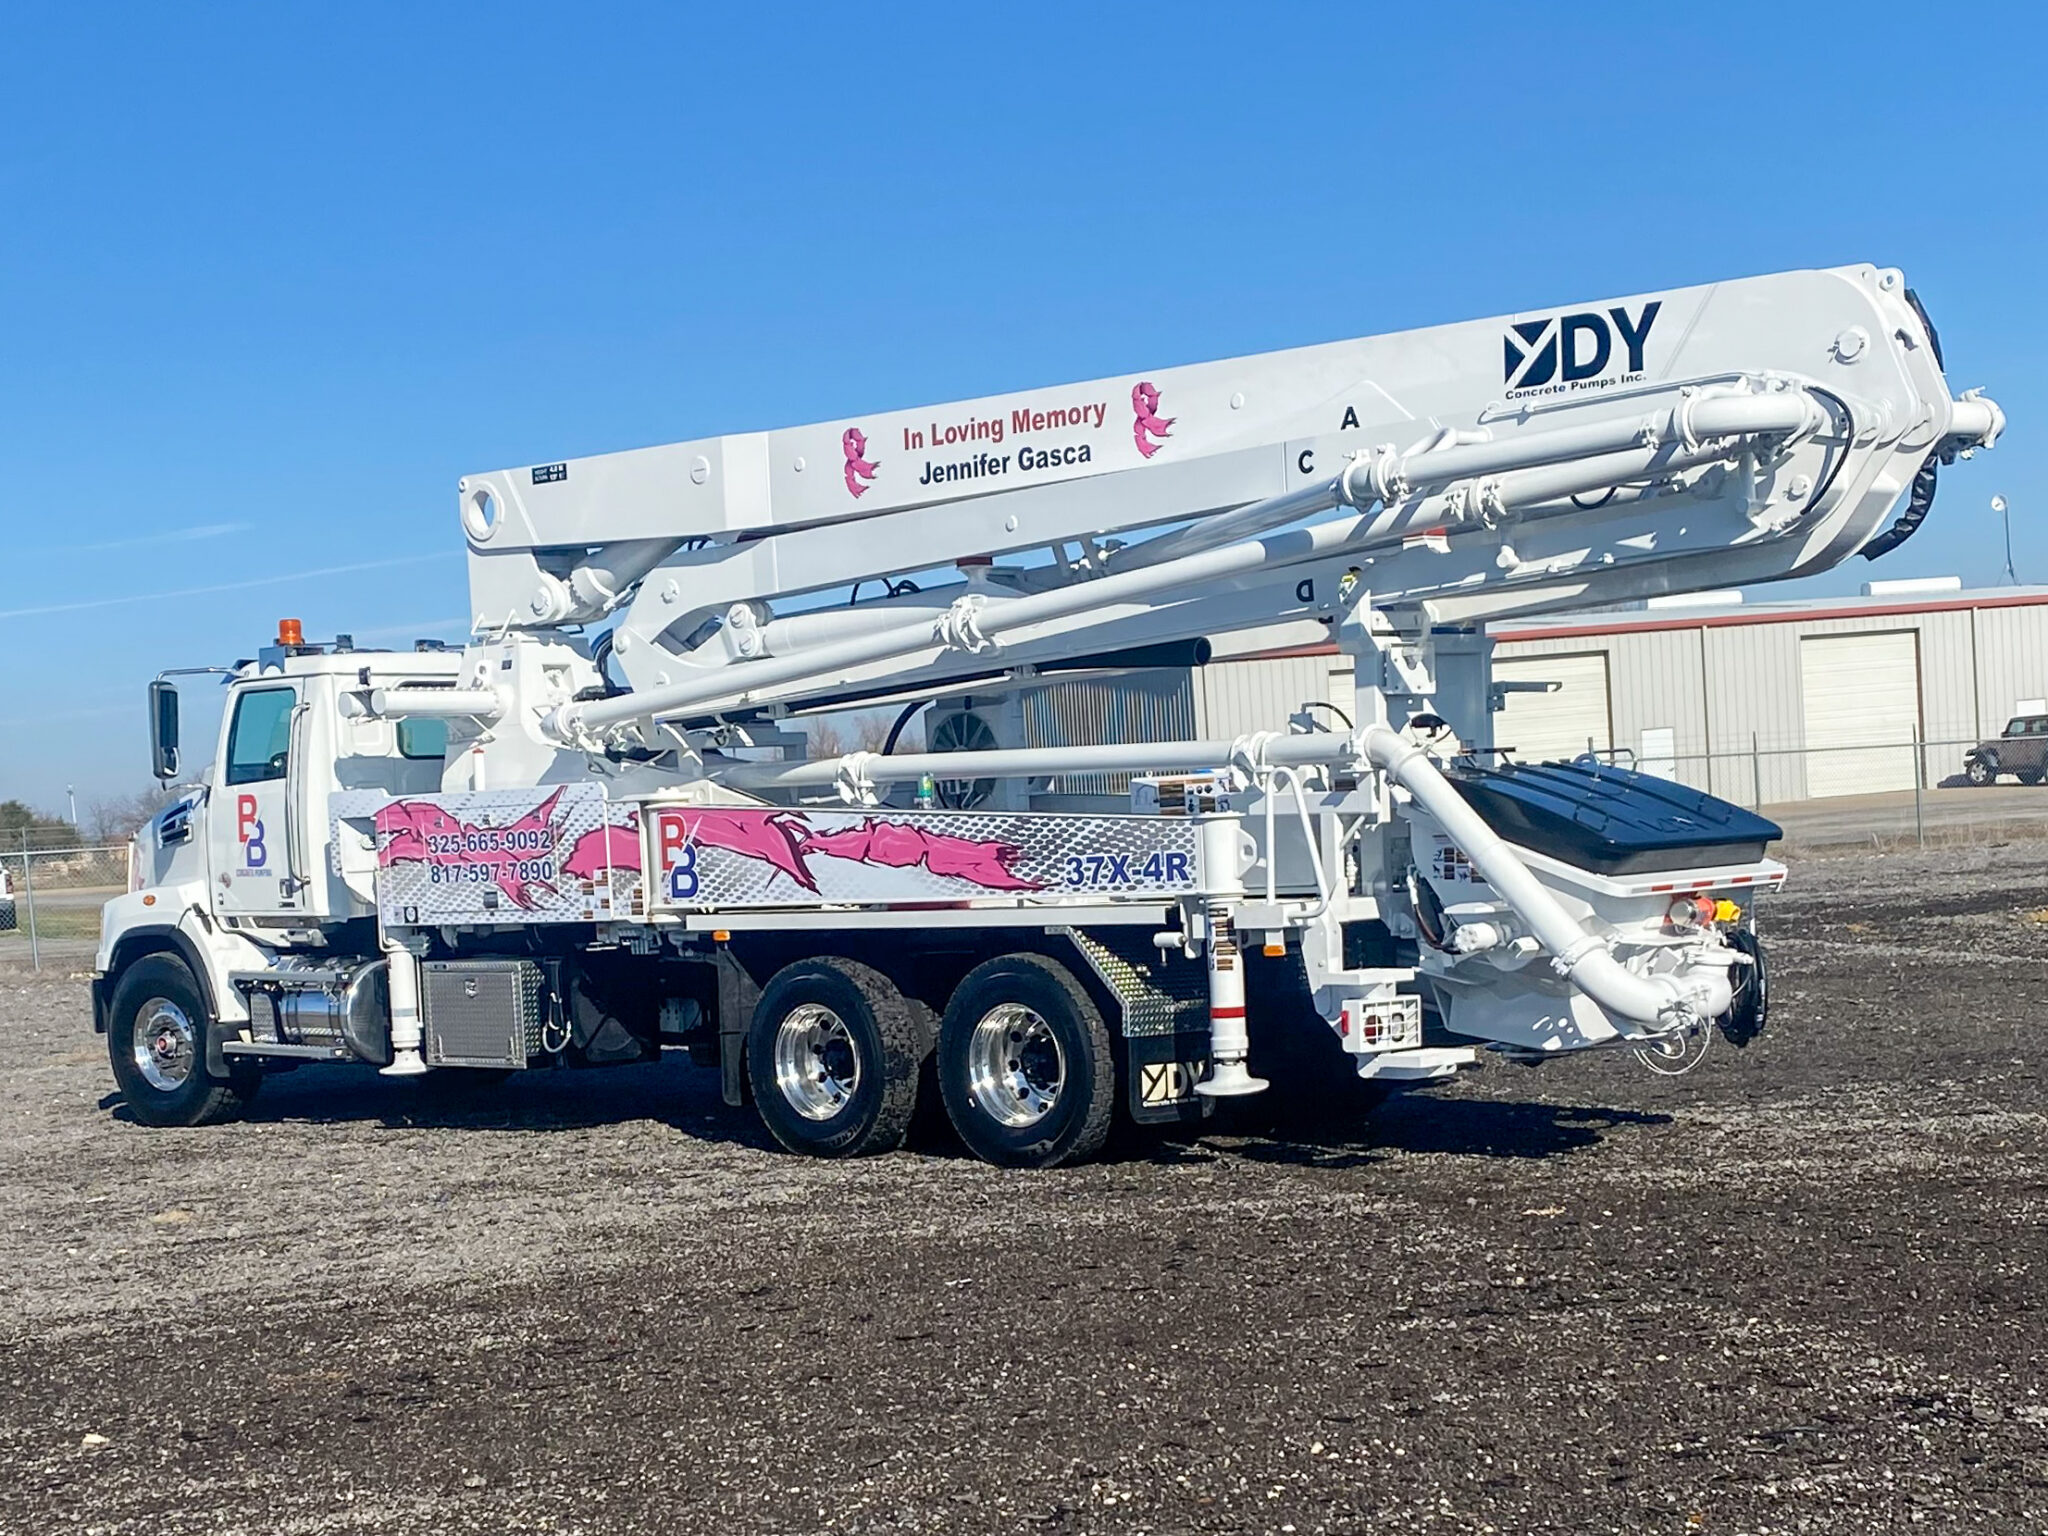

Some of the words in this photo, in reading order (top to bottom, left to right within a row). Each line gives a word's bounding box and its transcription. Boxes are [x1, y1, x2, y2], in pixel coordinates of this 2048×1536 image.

[1505, 385, 1566, 400] Concrete
[1571, 376, 1616, 390] Pumps
[1621, 373, 1647, 383] Inc.
[904, 427, 924, 451] In
[931, 417, 1004, 444] Loving
[1011, 402, 1107, 434] Memory
[1341, 406, 1360, 430] A
[919, 453, 1011, 486] Jennifer
[1017, 444, 1092, 472] Gasca
[1298, 450, 1314, 474] C
[1296, 578, 1315, 602] D
[428, 830, 551, 854] 325-665-9092
[430, 861, 552, 883] 817-597-7890
[1065, 852, 1191, 886] 37X-4R
